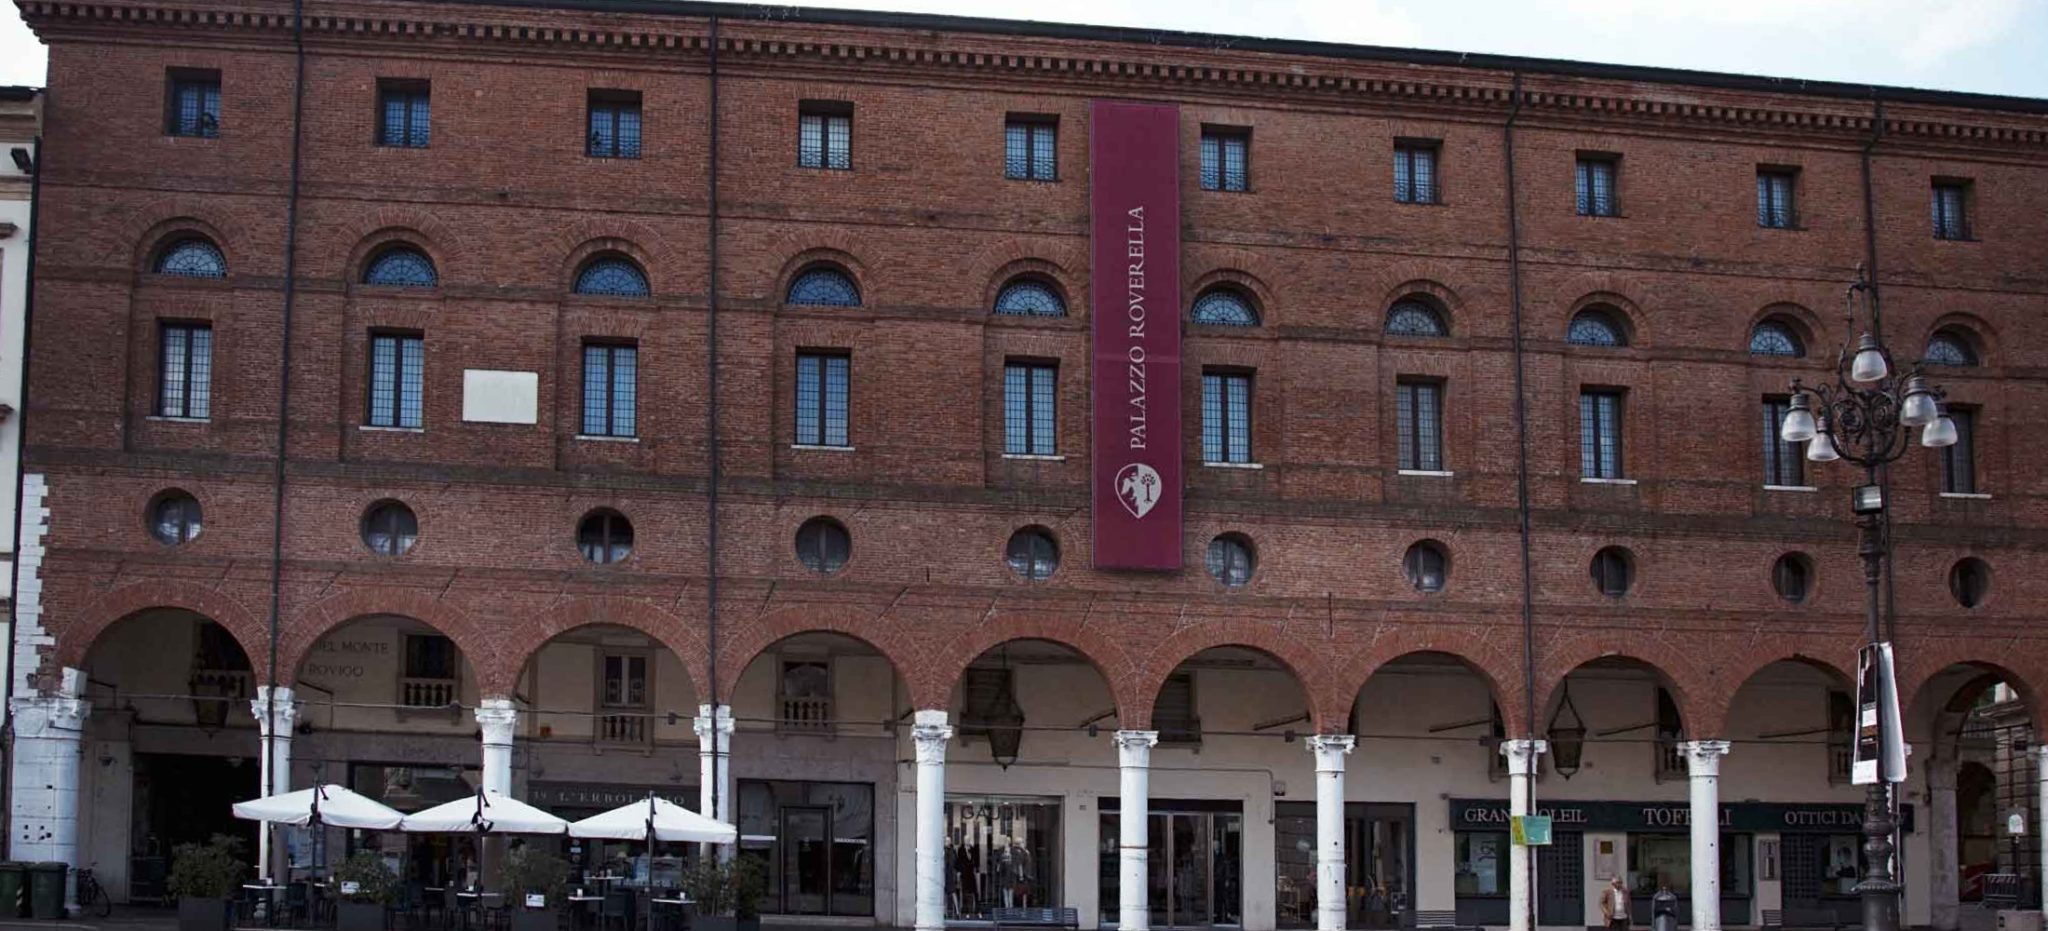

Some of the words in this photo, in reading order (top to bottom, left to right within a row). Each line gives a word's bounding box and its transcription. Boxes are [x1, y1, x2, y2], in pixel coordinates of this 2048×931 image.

[1128, 205, 1146, 339] ROVERELLA
[1129, 344, 1147, 451] PALAZZO
[558, 791, 685, 805] L'ERBOLO
[1464, 808, 1512, 823] GRAN
[1537, 808, 1588, 823] OLEIL
[1784, 810, 1836, 826] OTTICI
